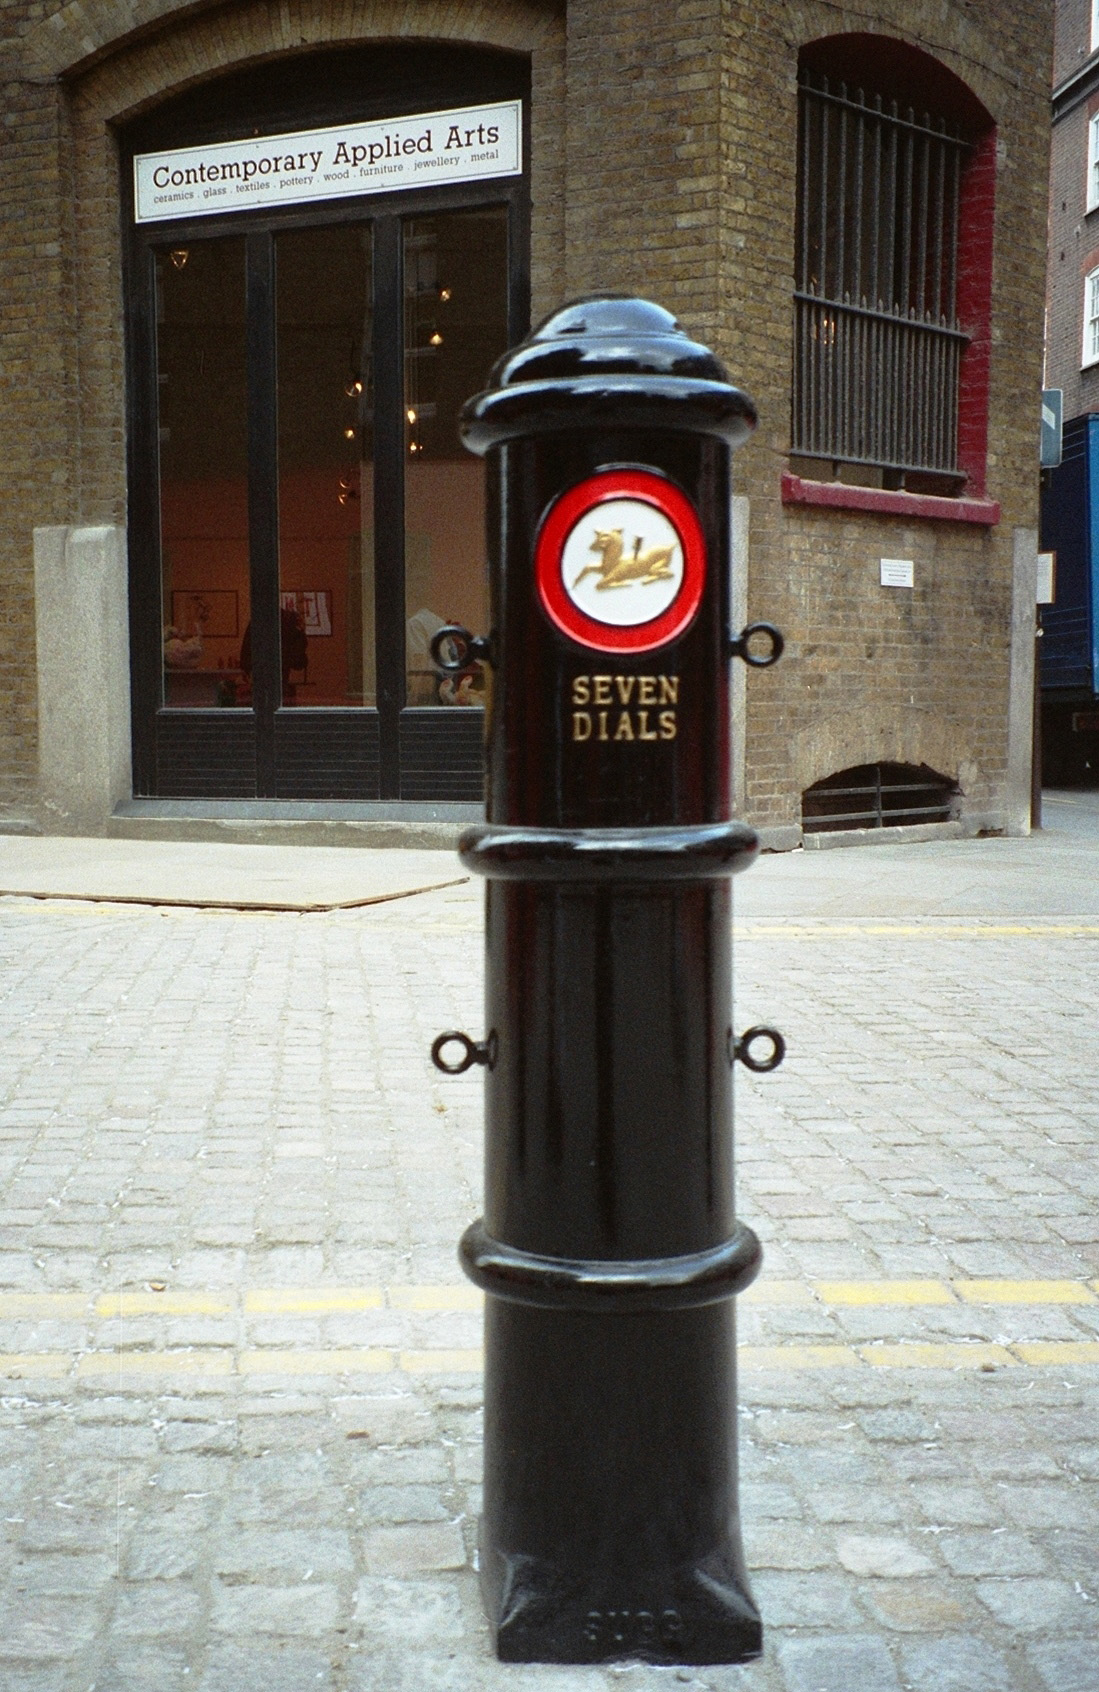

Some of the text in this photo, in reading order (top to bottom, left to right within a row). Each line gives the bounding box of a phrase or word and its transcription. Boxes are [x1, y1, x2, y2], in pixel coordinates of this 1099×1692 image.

[153, 123, 499, 188] Contemporary Applied Arts
[153, 149, 499, 204] ceramics glass textiles pottery wood furniture jewellery metal
[572, 675, 679, 705] SEVEN
[572, 711, 677, 741] DIALS
